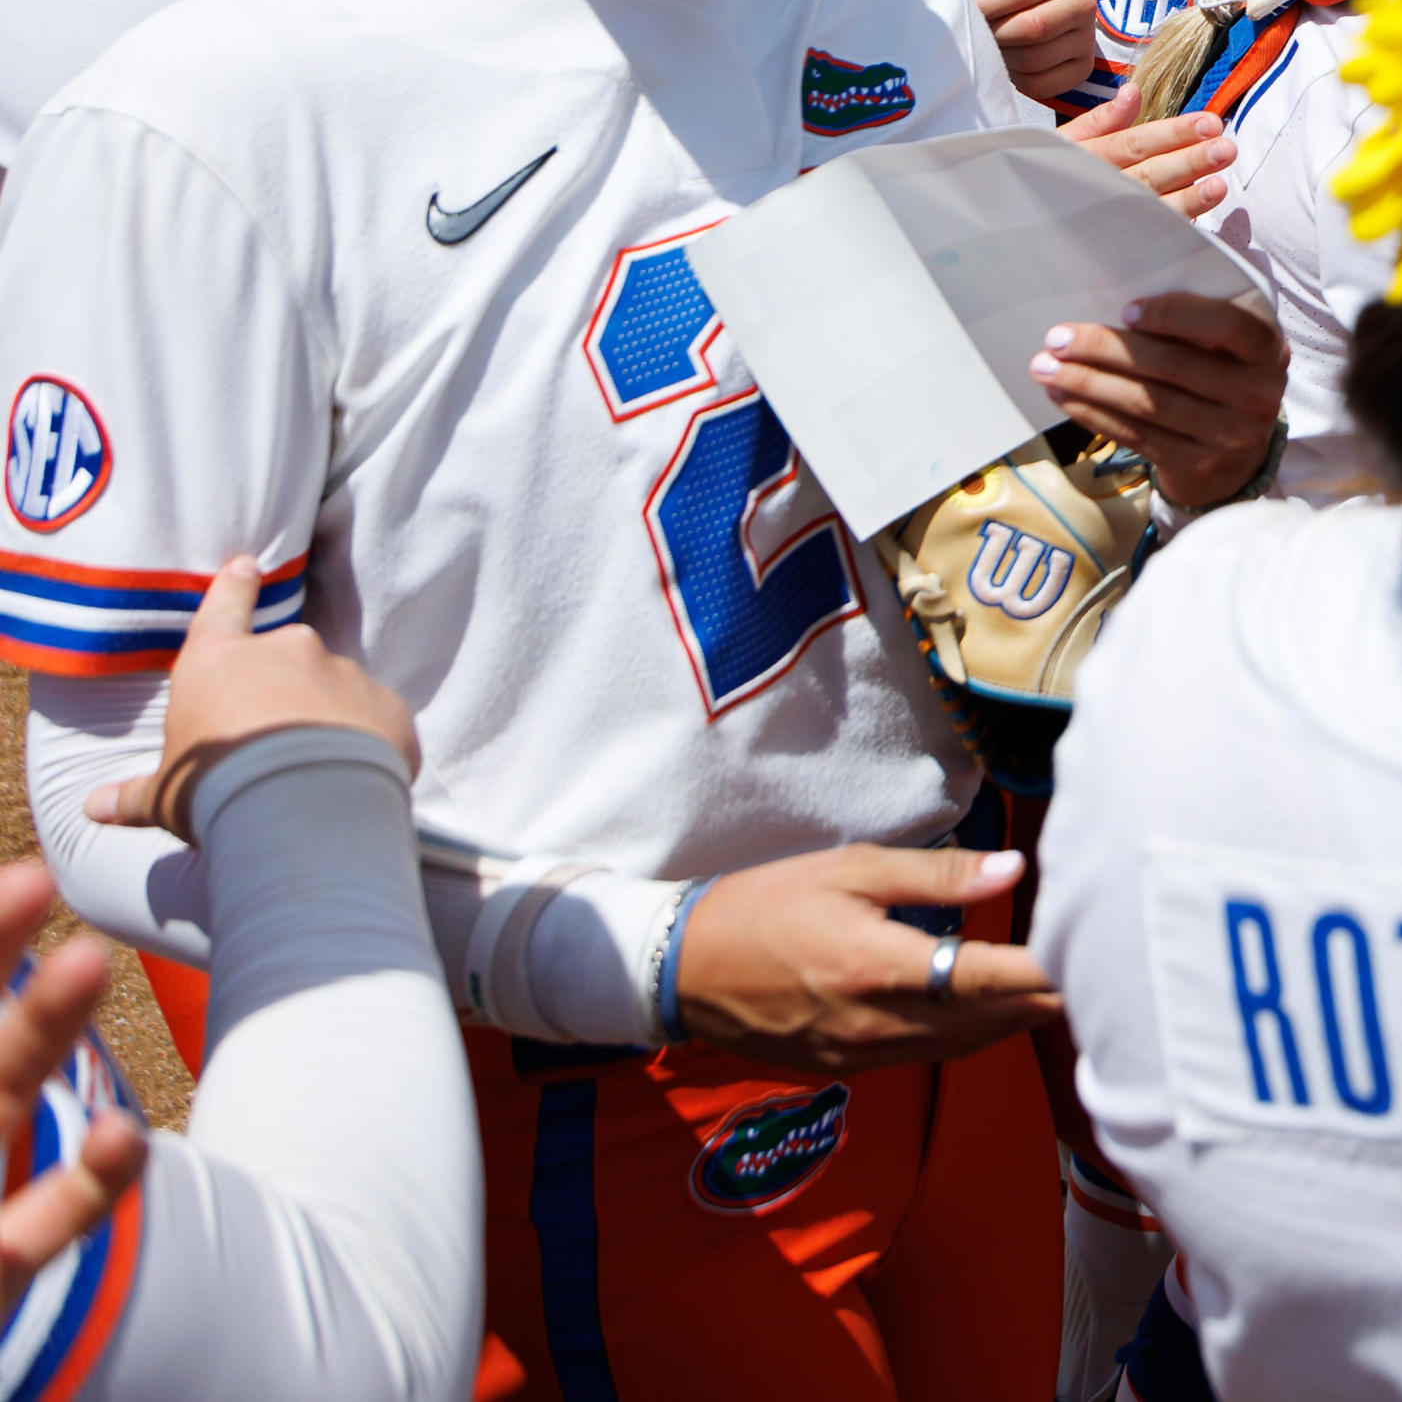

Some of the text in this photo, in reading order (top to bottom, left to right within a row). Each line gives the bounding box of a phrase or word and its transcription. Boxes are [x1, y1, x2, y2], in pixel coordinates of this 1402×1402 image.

[9, 382, 102, 520] SEC
[583, 215, 868, 725] 2
[967, 518, 1075, 620] W
